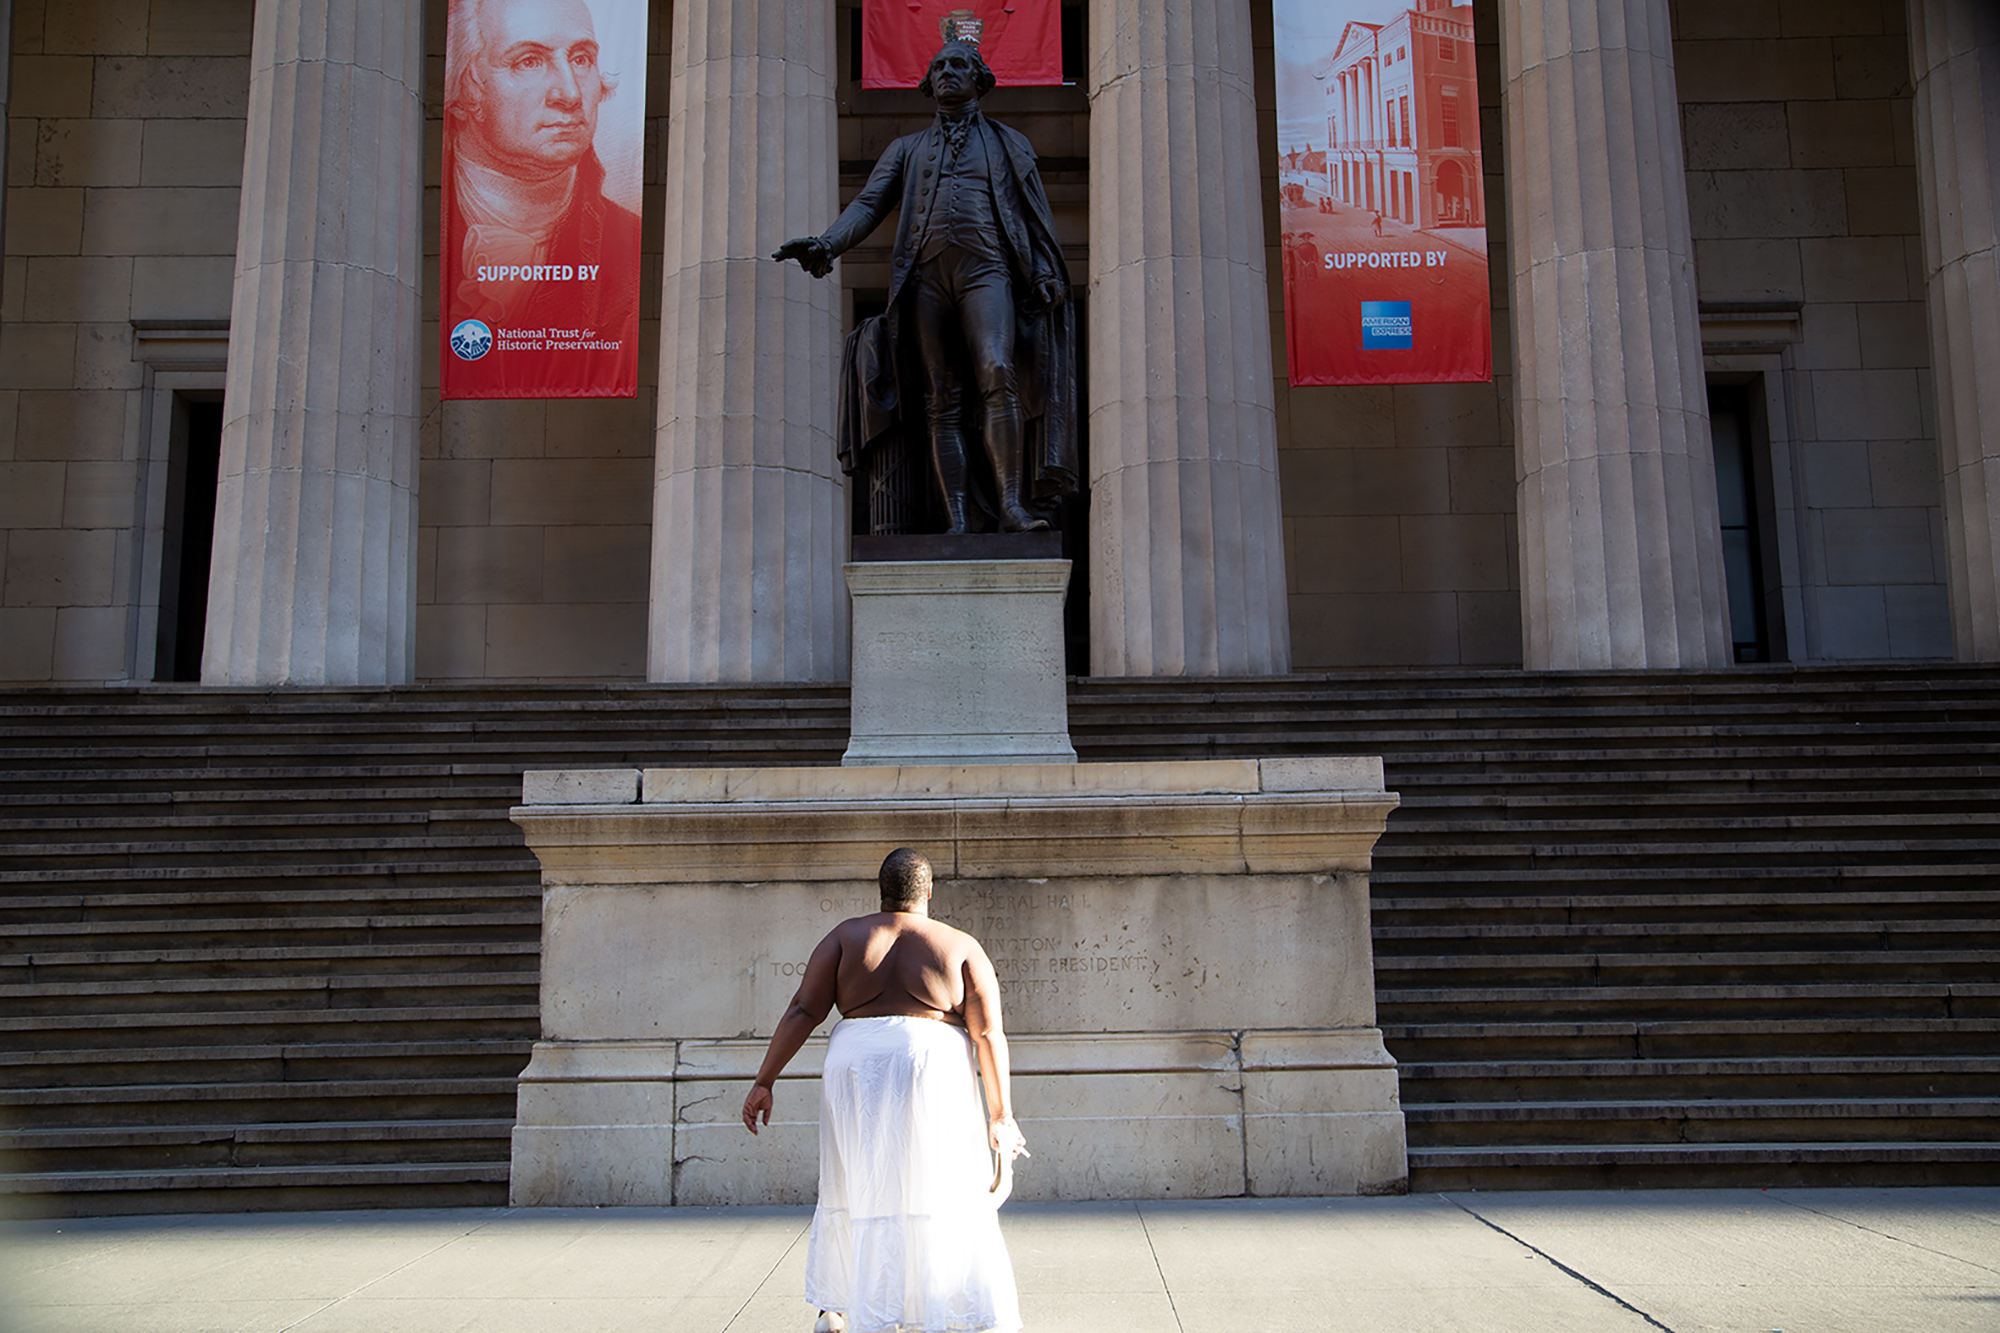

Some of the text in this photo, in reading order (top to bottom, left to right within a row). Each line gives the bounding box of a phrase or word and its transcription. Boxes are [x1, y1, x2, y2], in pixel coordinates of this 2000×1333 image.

[1324, 251, 1447, 269] SUPPORTED BY
[477, 265, 600, 282] SUPPORTED BY
[1362, 317, 1410, 326] AMERICAN
[497, 327, 596, 341] National Trust for
[1371, 327, 1412, 336] EXPRESS
[497, 339, 543, 350] Historic
[820, 898, 844, 912] ON
[852, 898, 878, 912] THI
[1047, 894, 1091, 910] HALL
[771, 962, 807, 976] TOO
